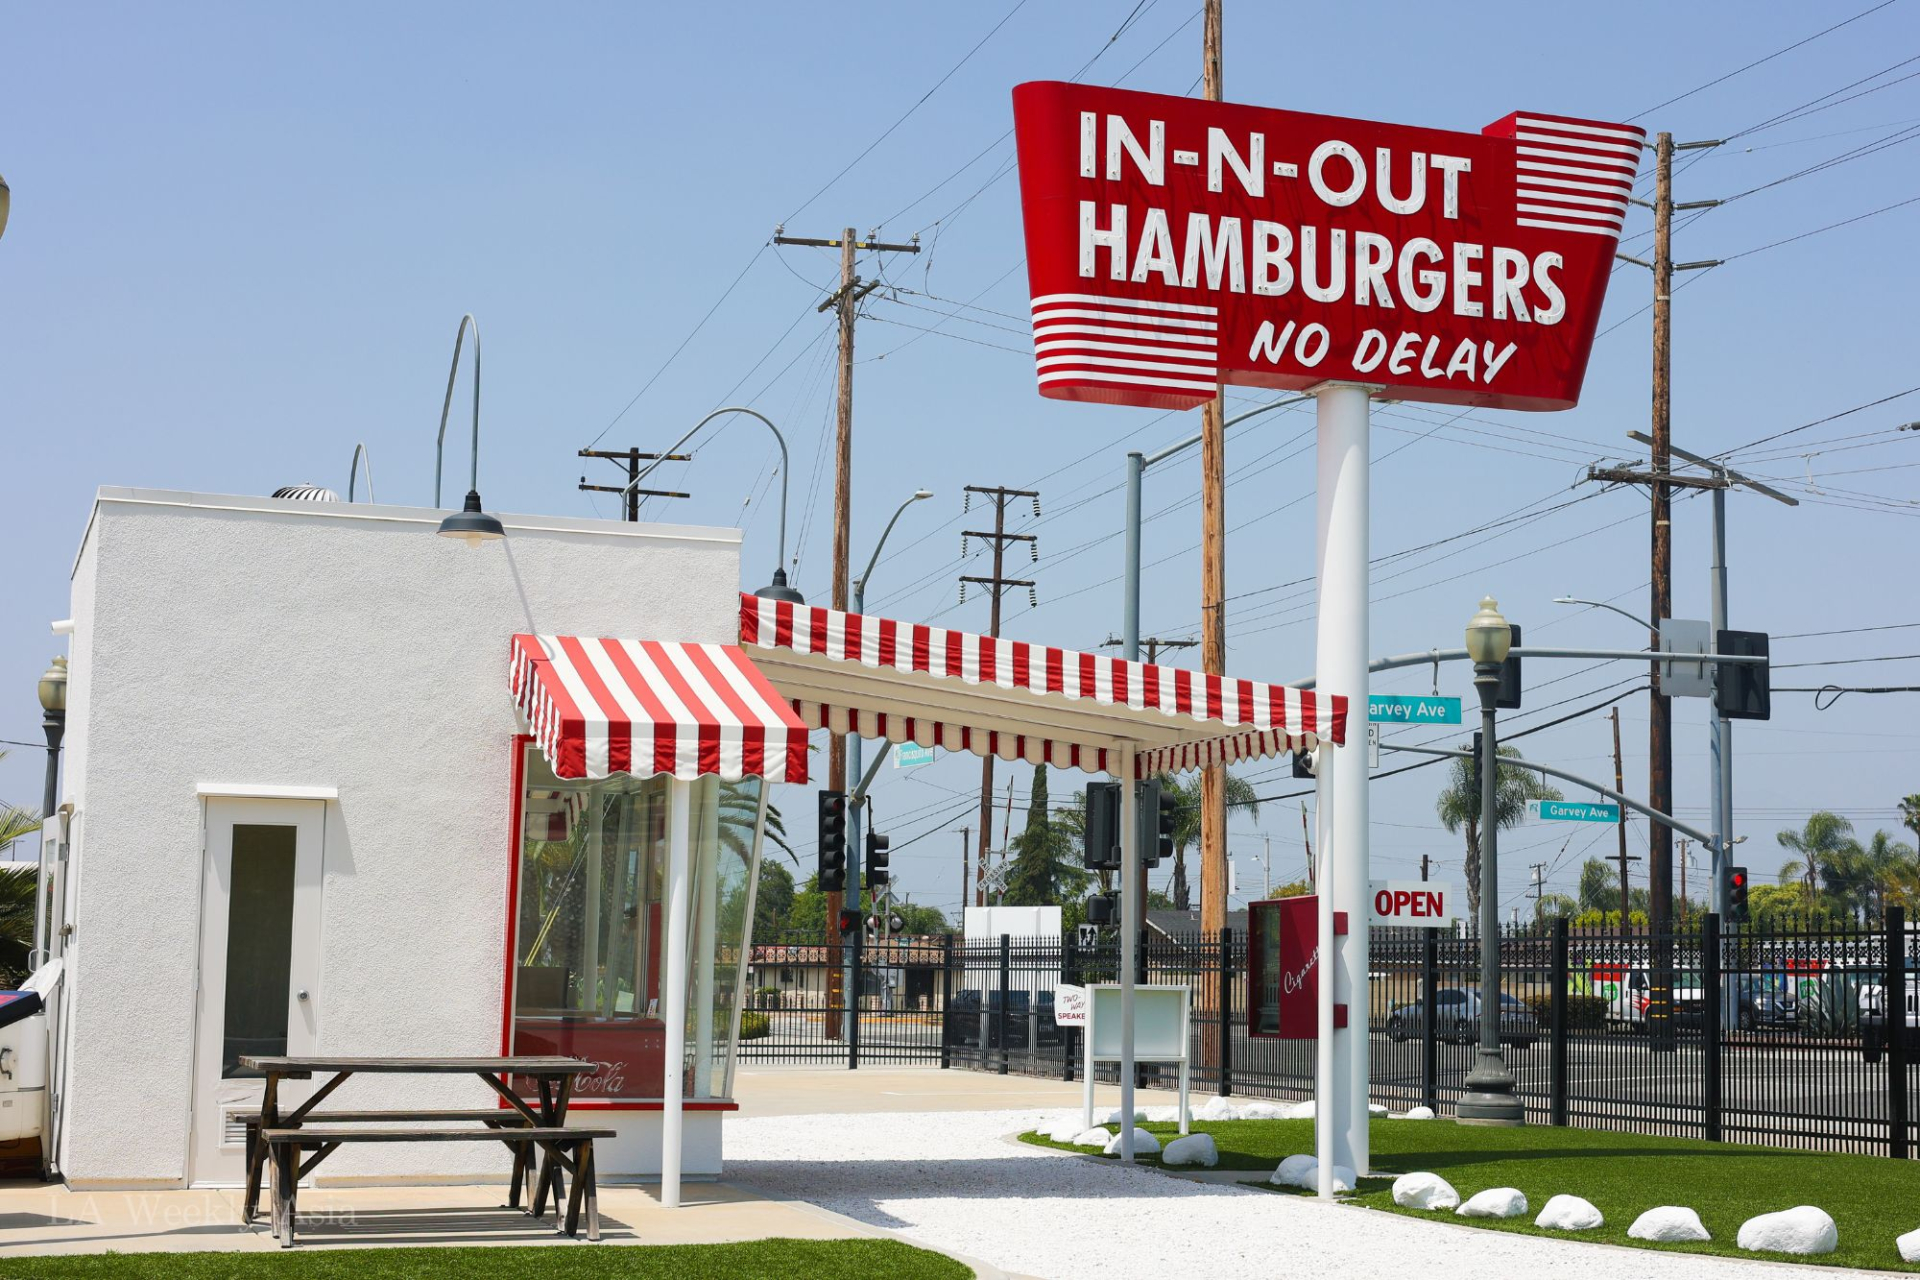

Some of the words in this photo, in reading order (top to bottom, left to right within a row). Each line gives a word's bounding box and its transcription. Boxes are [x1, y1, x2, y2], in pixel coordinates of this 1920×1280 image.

[1080, 111, 1472, 219] IN-N-OUT
[1079, 200, 1566, 325] HAMBURGERS
[1249, 320, 1330, 368] NO
[1351, 328, 1518, 384] DELAY
[1369, 703, 1412, 719] arvey
[1416, 702, 1446, 717] Ave
[1550, 805, 1587, 819] Garvey
[1589, 807, 1609, 818] Ave
[979, 859, 991, 874] RAIL
[979, 861, 1007, 889] CROSSING
[1375, 890, 1443, 917] OPEN
[1057, 1012, 1085, 1020] SPEAKE
[1070, 1001, 1085, 1011] WAY
